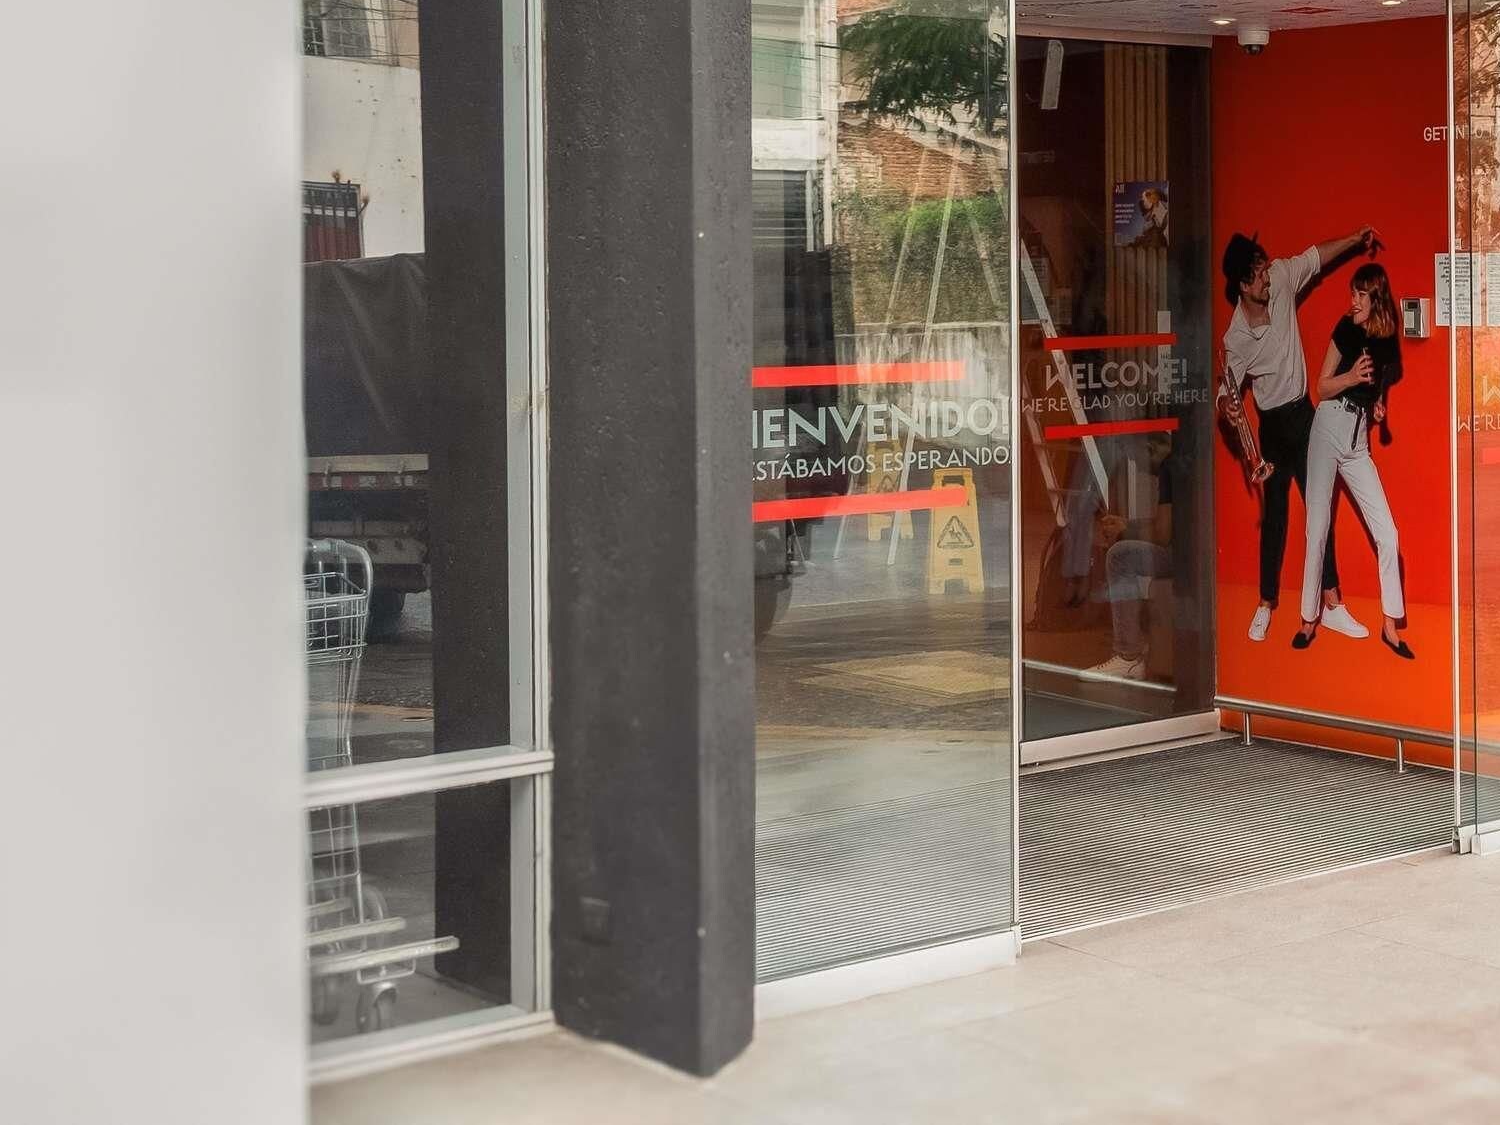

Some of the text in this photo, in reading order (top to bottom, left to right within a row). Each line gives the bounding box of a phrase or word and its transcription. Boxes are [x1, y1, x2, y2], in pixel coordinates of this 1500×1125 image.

[1423, 126, 1448, 142] GET
[1046, 358, 1188, 392] WELCOME!
[1174, 387, 1208, 404] HERE
[752, 453, 876, 481] STÁBAMOS
